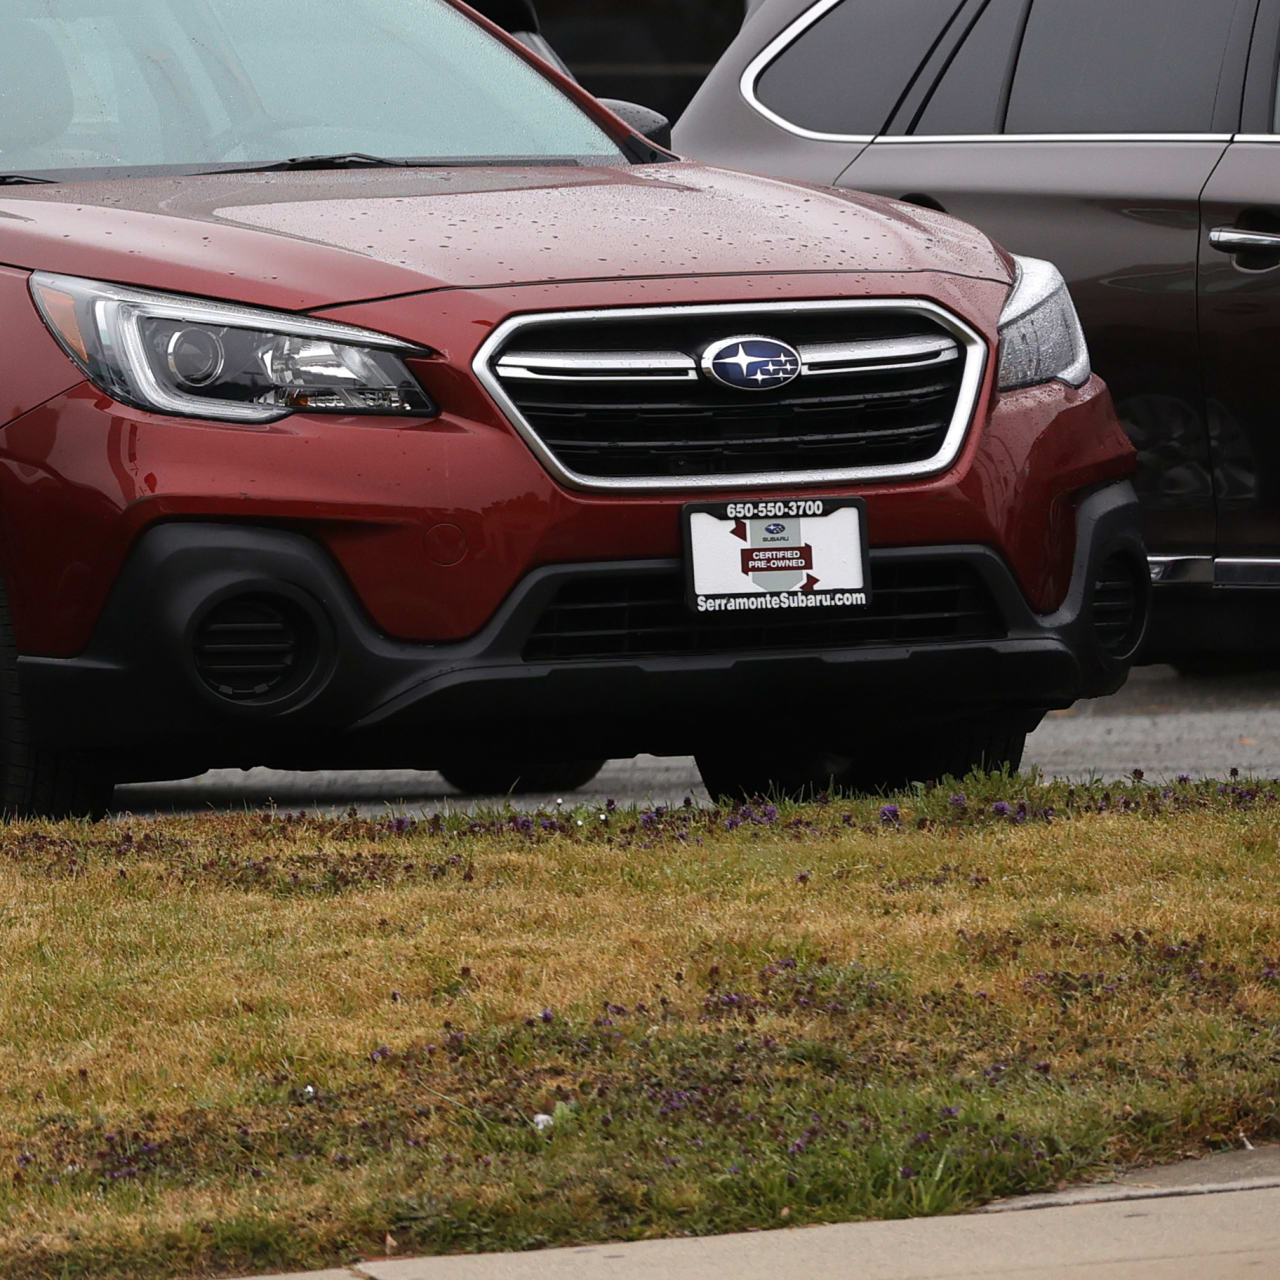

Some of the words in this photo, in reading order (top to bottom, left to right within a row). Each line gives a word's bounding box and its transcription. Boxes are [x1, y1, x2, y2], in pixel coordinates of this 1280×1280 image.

[726, 500, 824, 518] 650-550-3700
[752, 550, 801, 560] CERTIFIED
[748, 558, 806, 569] PRE-OWNED
[697, 591, 867, 612] SerramonteSubaru.com
